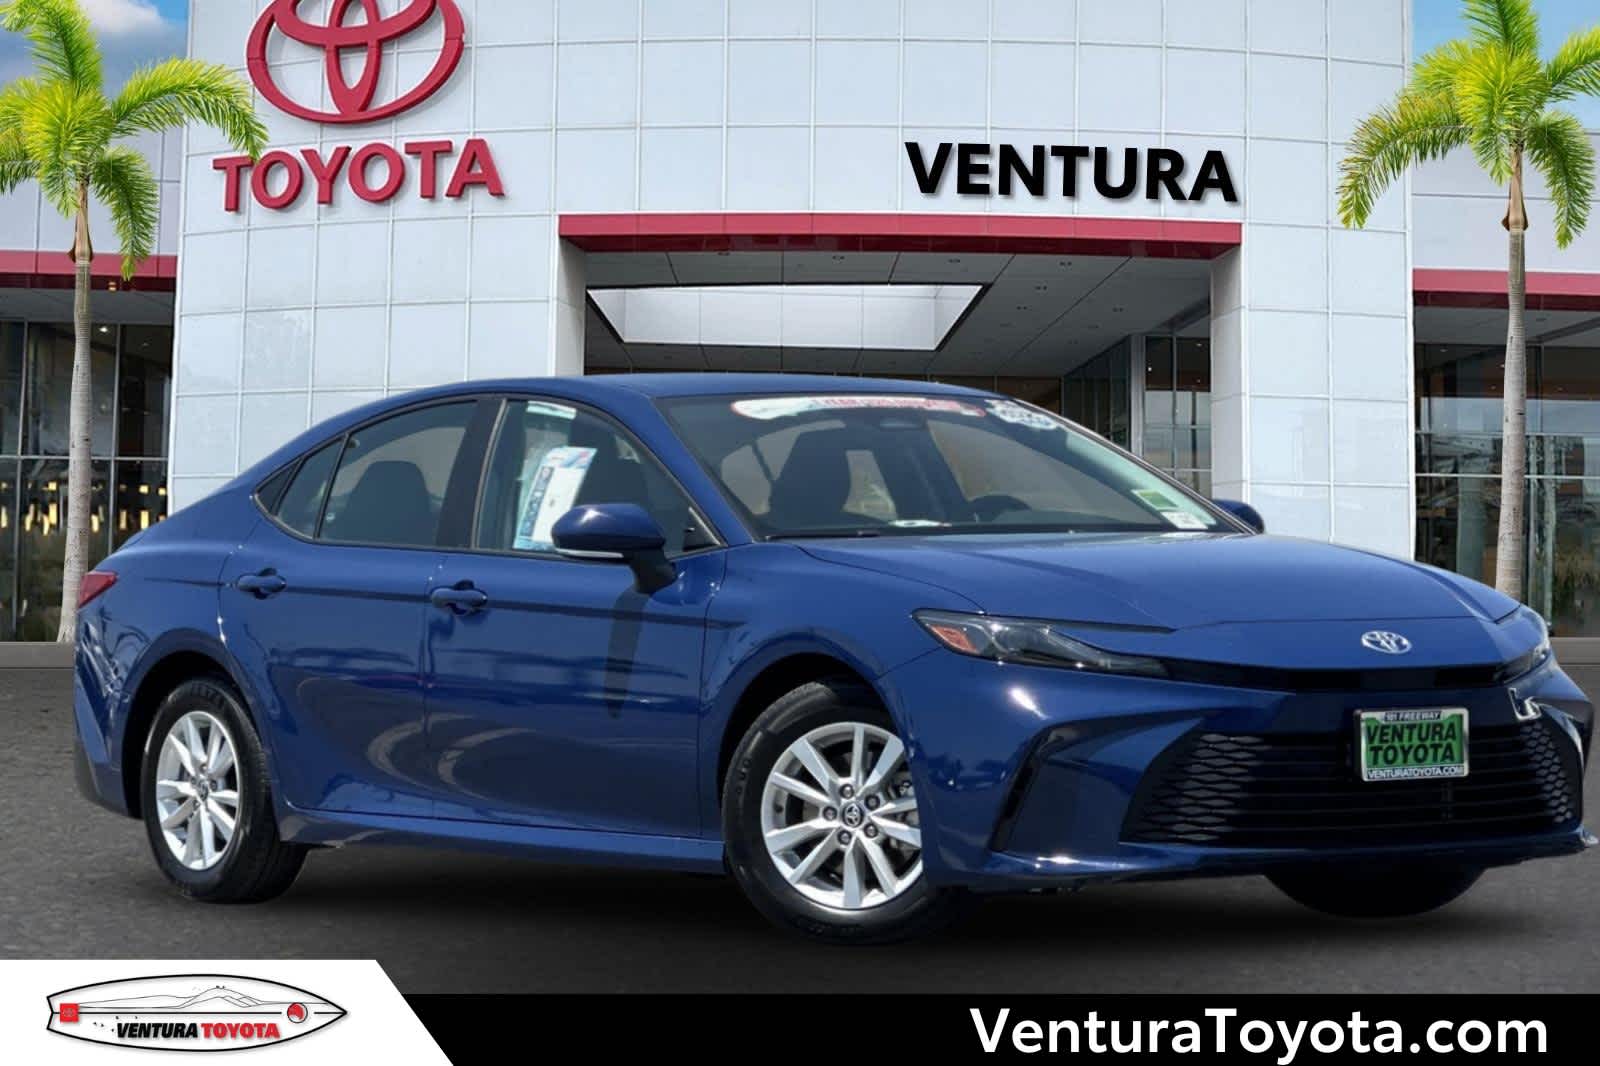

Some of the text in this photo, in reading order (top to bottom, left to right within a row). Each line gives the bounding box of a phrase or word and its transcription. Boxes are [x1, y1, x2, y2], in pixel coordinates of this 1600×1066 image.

[212, 138, 505, 212] TOYOTA
[904, 141, 1239, 203] VENTURA
[1366, 723, 1457, 744] VENTURA
[1369, 742, 1455, 766] TOYOTA
